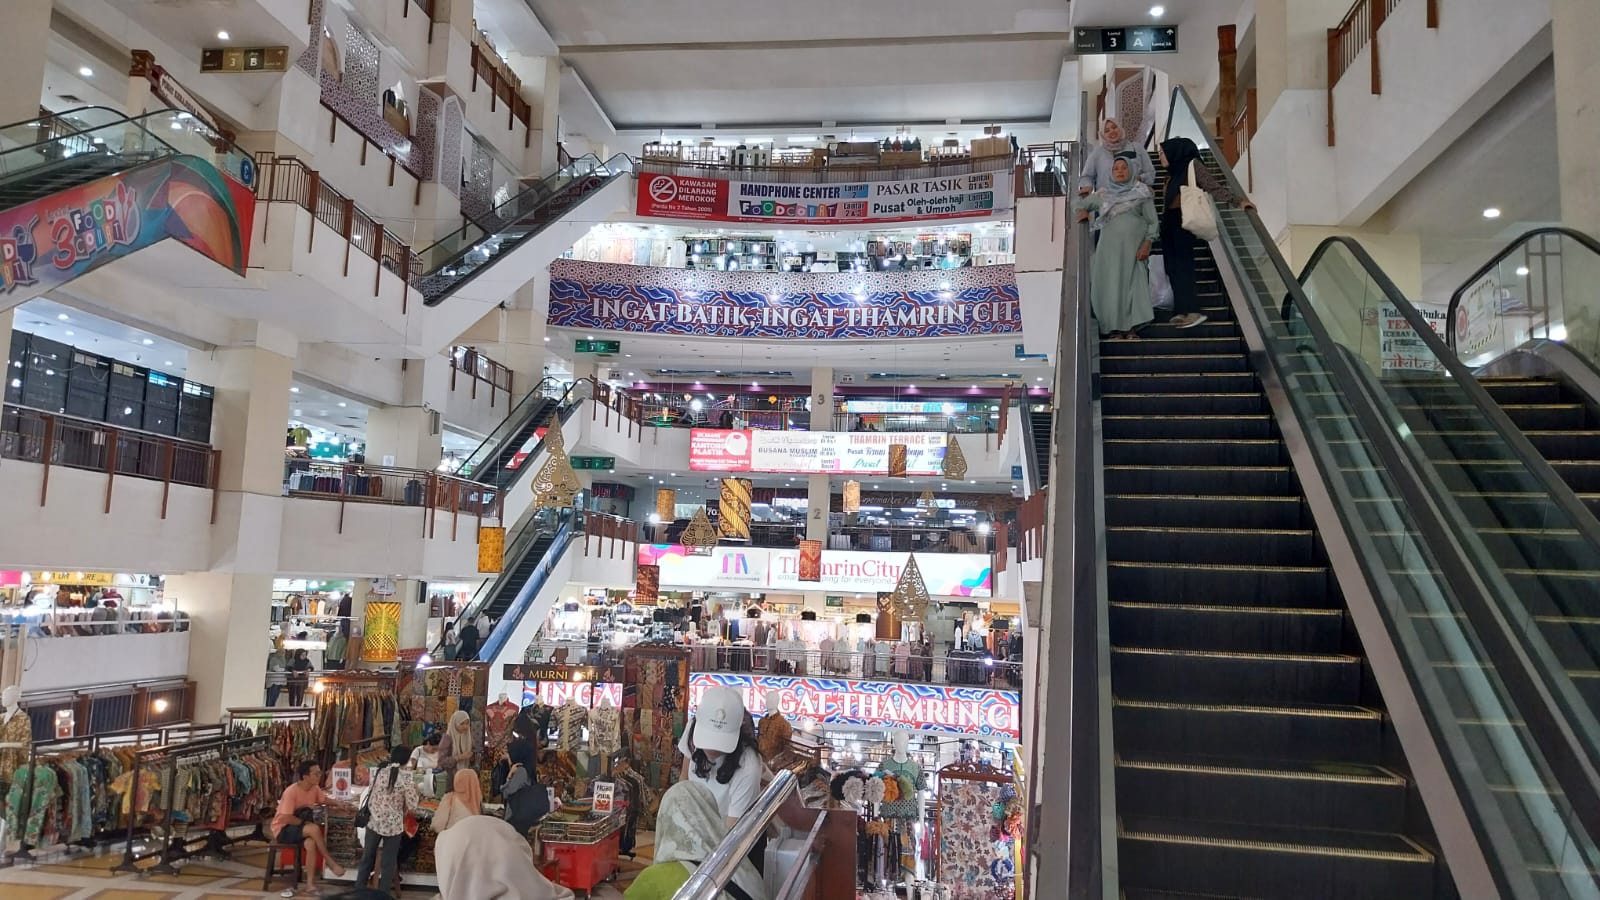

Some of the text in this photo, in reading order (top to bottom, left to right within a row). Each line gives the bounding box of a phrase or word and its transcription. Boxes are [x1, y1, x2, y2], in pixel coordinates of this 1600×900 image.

[1110, 37, 1117, 47] 3
[1133, 38, 1144, 47] A
[679, 180, 717, 188] KAWASAN
[877, 178, 962, 196] PASAR TASIK
[678, 188, 717, 196] DILARANG
[740, 183, 840, 199] HANDPHONE CENTER
[678, 195, 716, 203] MEROKOK
[907, 196, 948, 207] Oleh-oleh
[873, 202, 905, 213] Pusat
[926, 205, 956, 214] Umroh
[592, 297, 670, 322] INGAT
[763, 307, 838, 328] INGAT
[847, 304, 966, 328] THAMRIN
[817, 394, 825, 405] 3
[849, 434, 926, 444] THAMRIN TERRACE
[813, 509, 822, 520] 2
[529, 670, 568, 680] MURNI
[840, 692, 981, 727] THAMRIN
